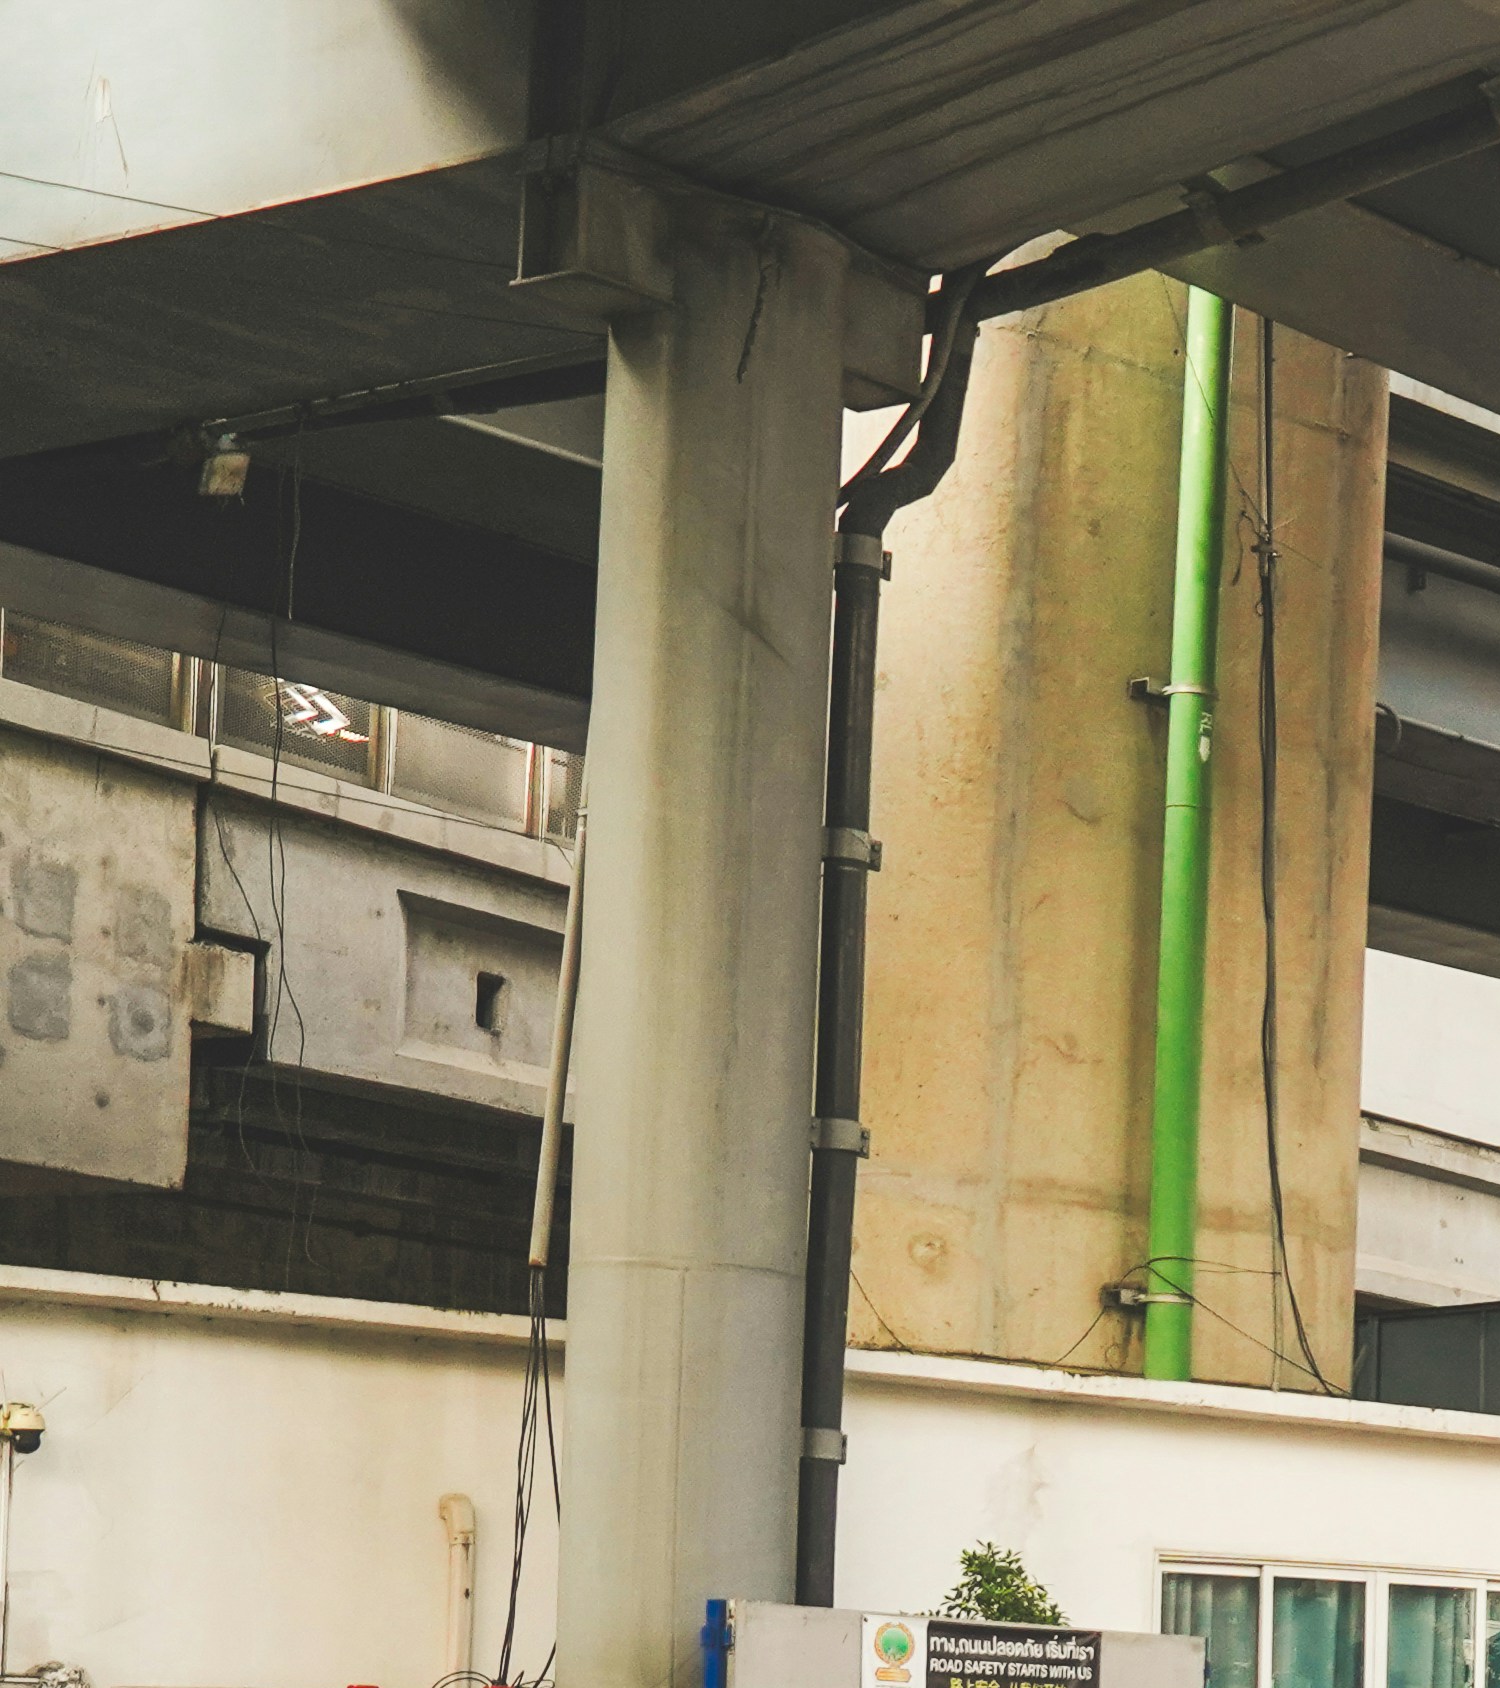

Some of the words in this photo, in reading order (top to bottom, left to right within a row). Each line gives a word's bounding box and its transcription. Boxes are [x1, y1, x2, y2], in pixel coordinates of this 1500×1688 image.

[929, 1658, 963, 1673] ROAD
[965, 1660, 1007, 1676] SAFETY
[1007, 1662, 1048, 1678] STARTS
[1050, 1665, 1076, 1679] WITH
[1077, 1666, 1093, 1680] US
